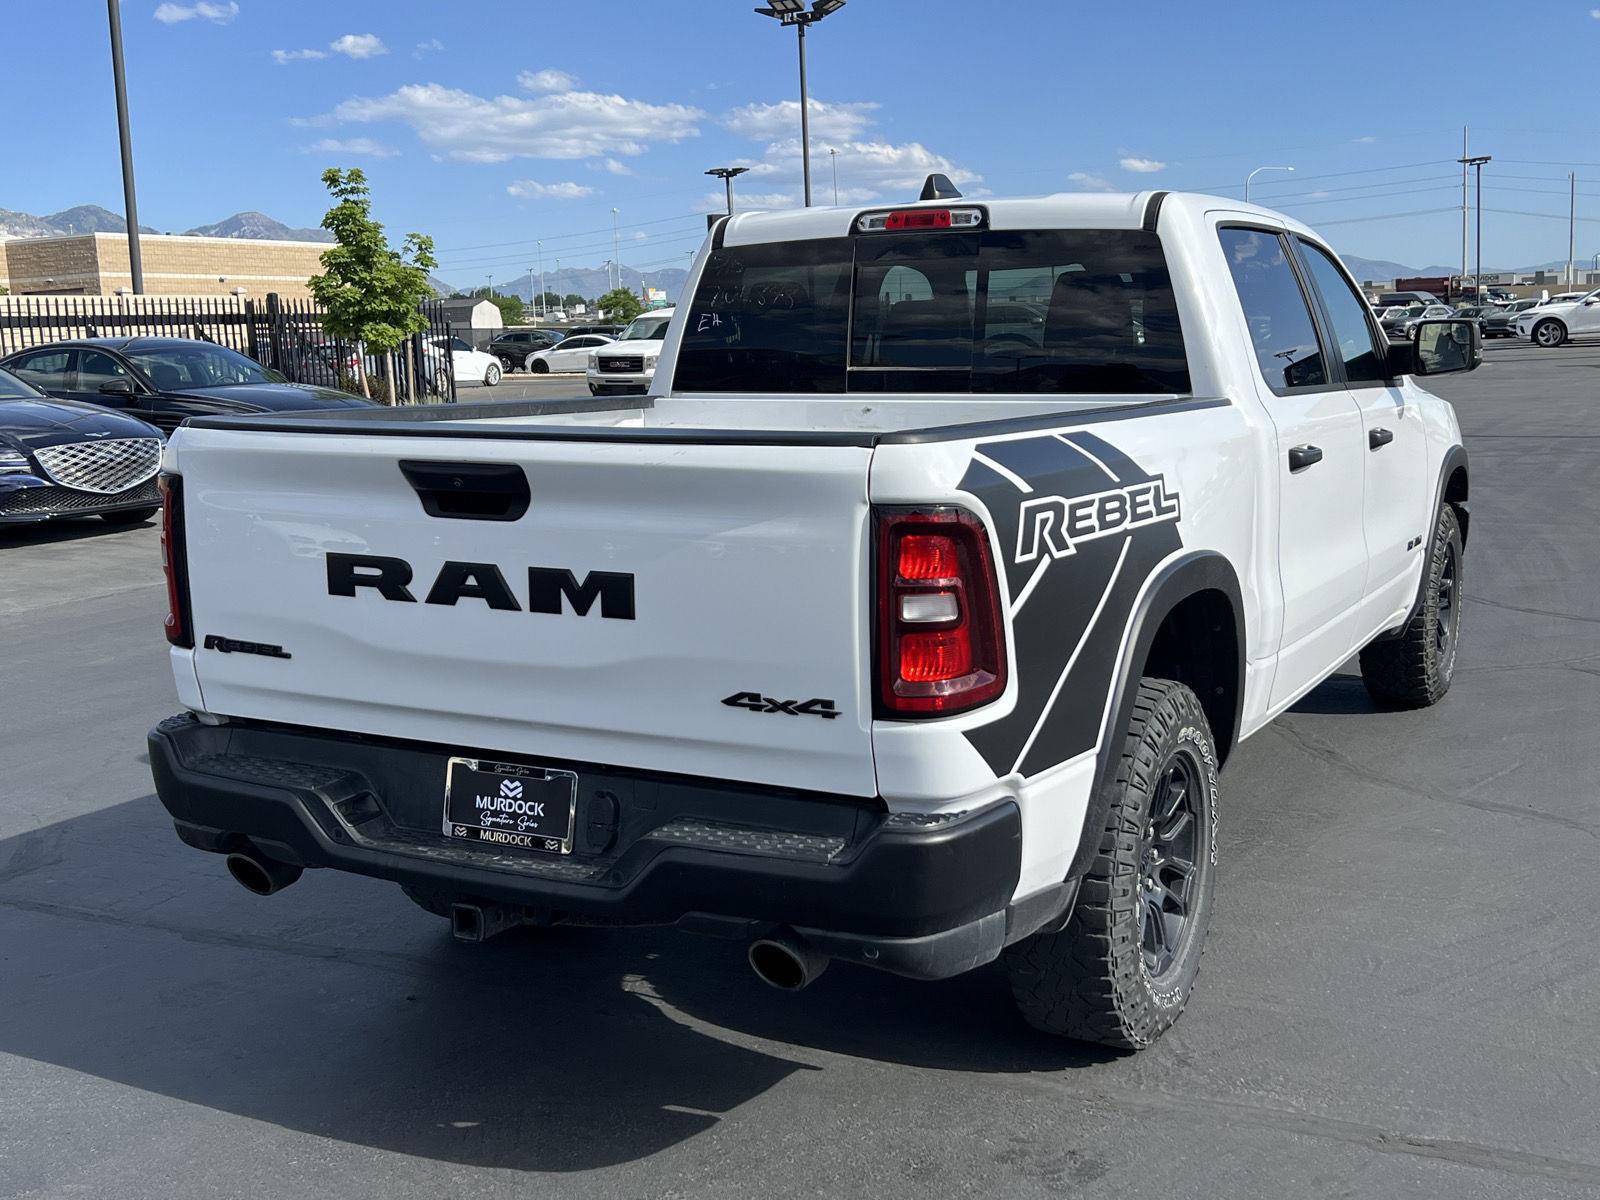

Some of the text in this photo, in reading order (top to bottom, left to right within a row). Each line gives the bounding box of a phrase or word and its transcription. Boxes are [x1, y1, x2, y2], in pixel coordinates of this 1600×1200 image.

[1015, 479, 1179, 564] REBEL
[326, 552, 636, 620] RAM
[204, 634, 292, 659] REBEL
[475, 794, 545, 817] MURDOCK
[480, 810, 539, 831] Signature Series
[480, 829, 532, 848] MURDOCK
